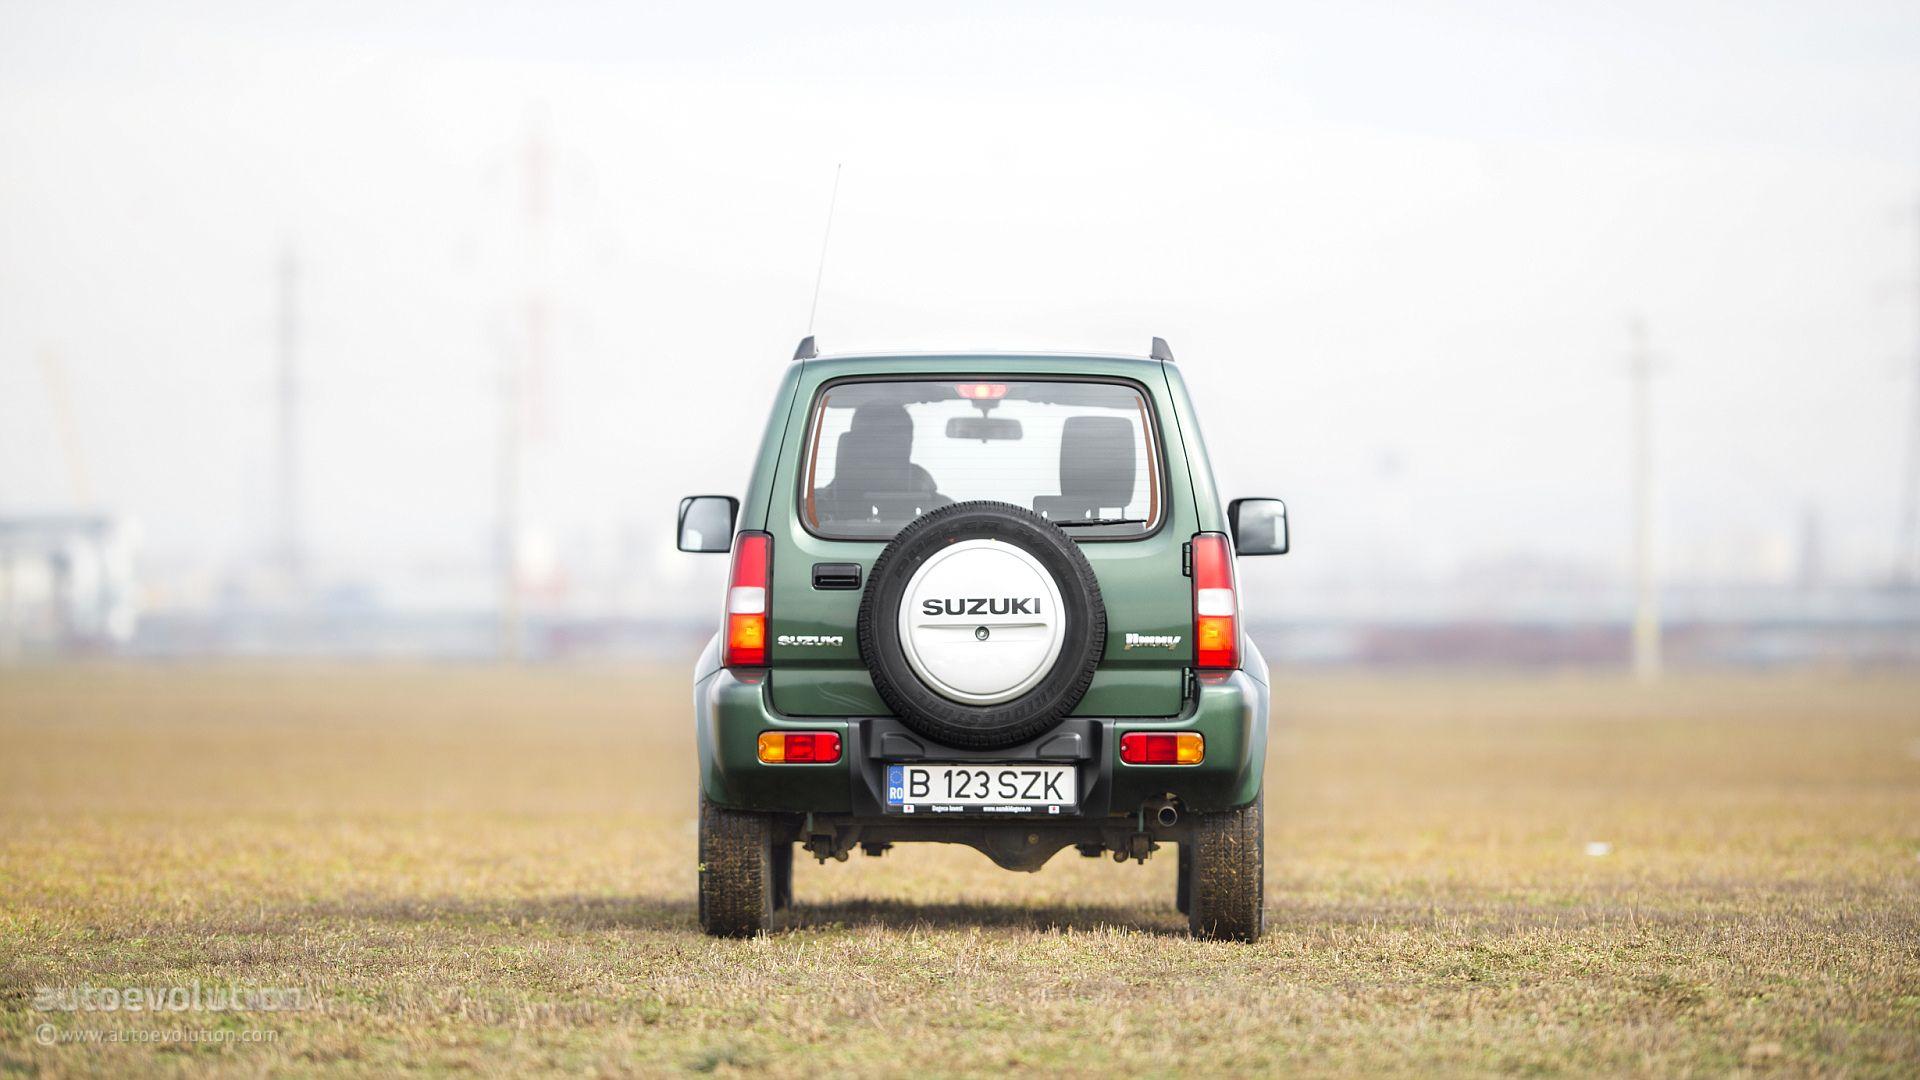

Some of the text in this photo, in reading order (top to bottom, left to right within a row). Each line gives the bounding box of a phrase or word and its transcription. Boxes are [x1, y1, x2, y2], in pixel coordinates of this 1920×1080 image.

[922, 598, 1041, 616] SUZUKI
[889, 786, 904, 800] RO
[909, 769, 1063, 800] B 123 SZK
